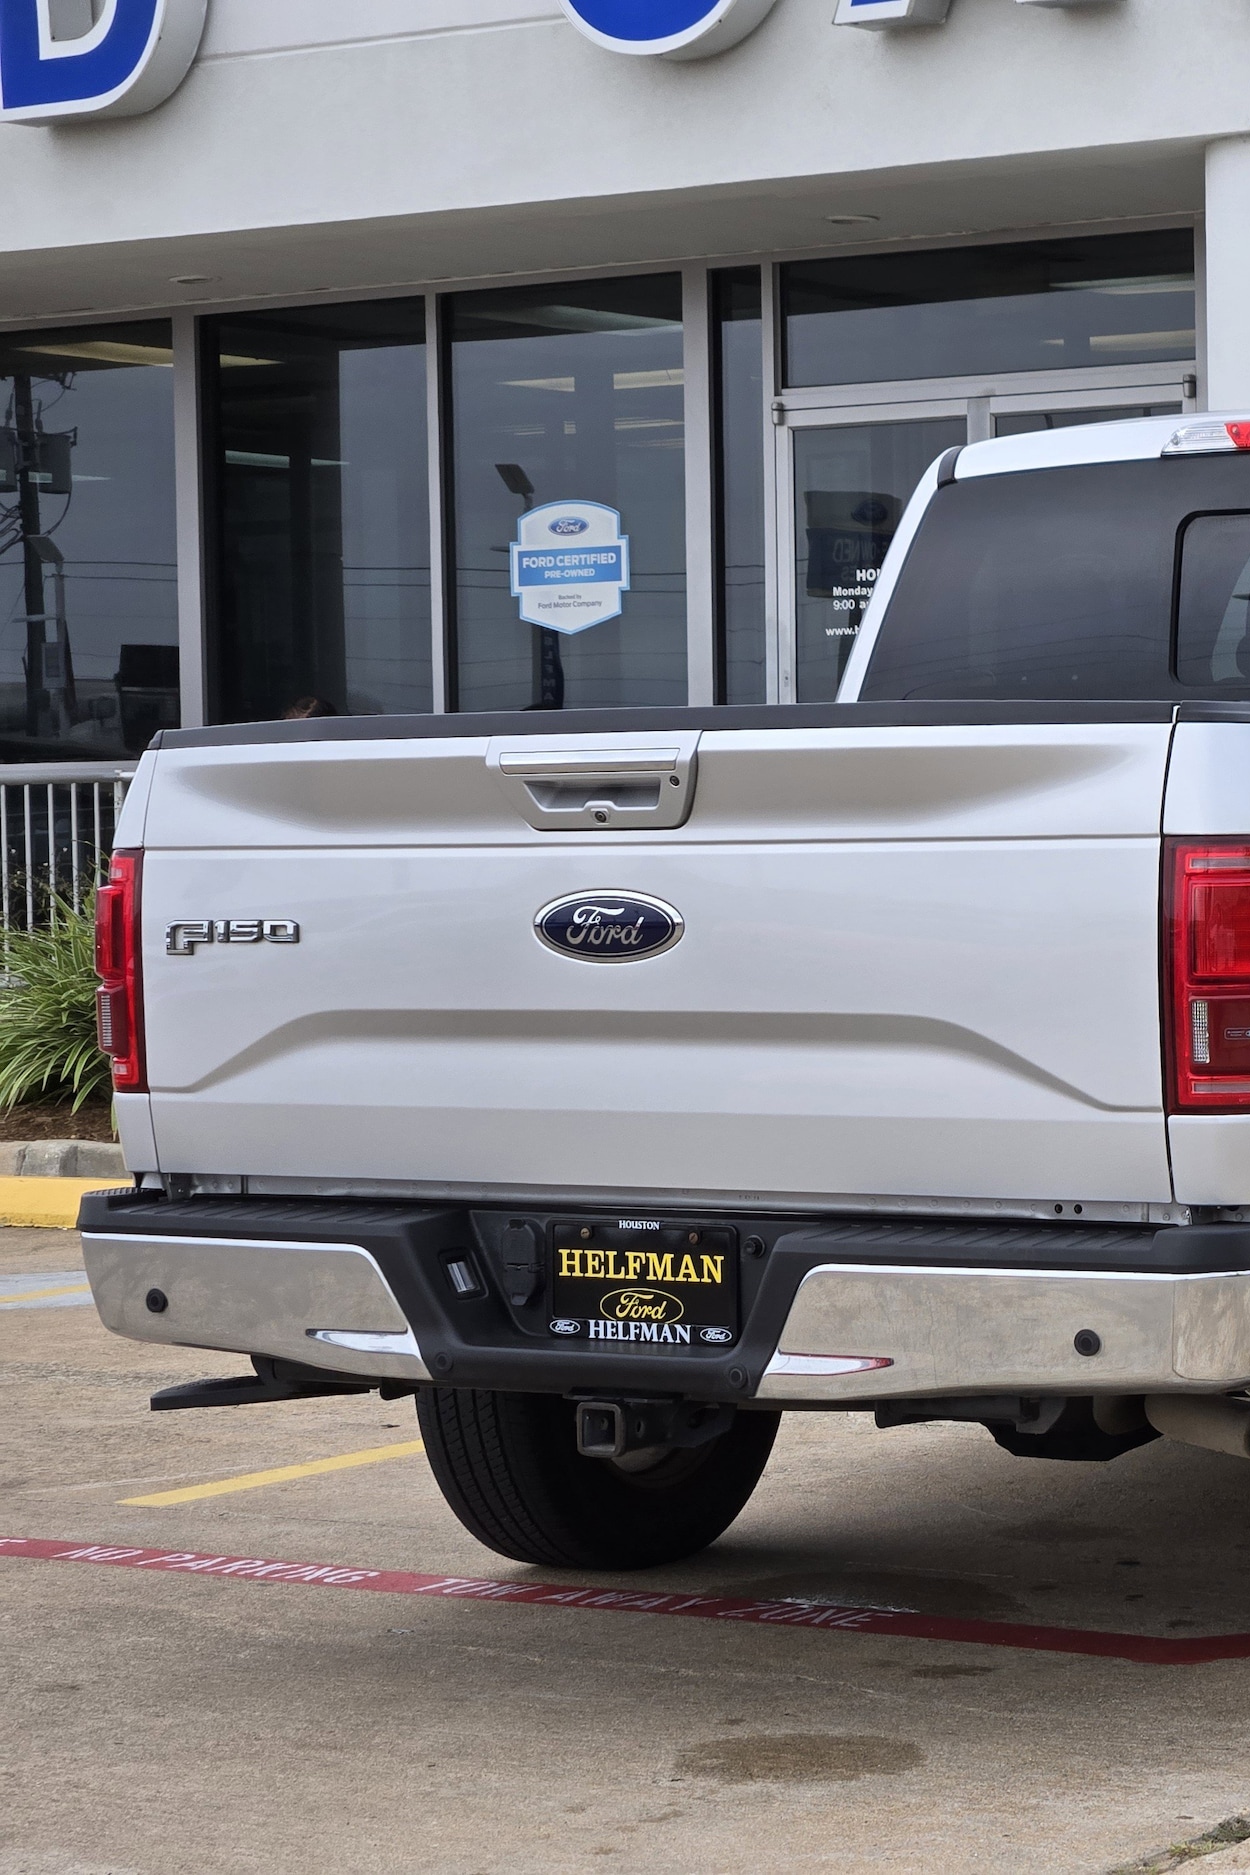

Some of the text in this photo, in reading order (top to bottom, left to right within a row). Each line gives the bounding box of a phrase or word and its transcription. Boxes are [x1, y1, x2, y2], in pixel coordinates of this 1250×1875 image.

[556, 520, 581, 532] Ford
[522, 552, 617, 568] FORD CERTIFIED
[544, 568, 595, 579] PRE-OWNED
[553, 601, 572, 609] Motor
[573, 600, 602, 609] Company
[833, 600, 855, 610] 9:00
[566, 906, 645, 945] Ford
[618, 1220, 660, 1230] HOUSTON
[558, 1249, 725, 1284] HELFMAN
[615, 1292, 668, 1320] Ford
[588, 1319, 692, 1344] HELFMAN
[51, 1546, 894, 1628] NO PARKING TOW AWAY ZONE
